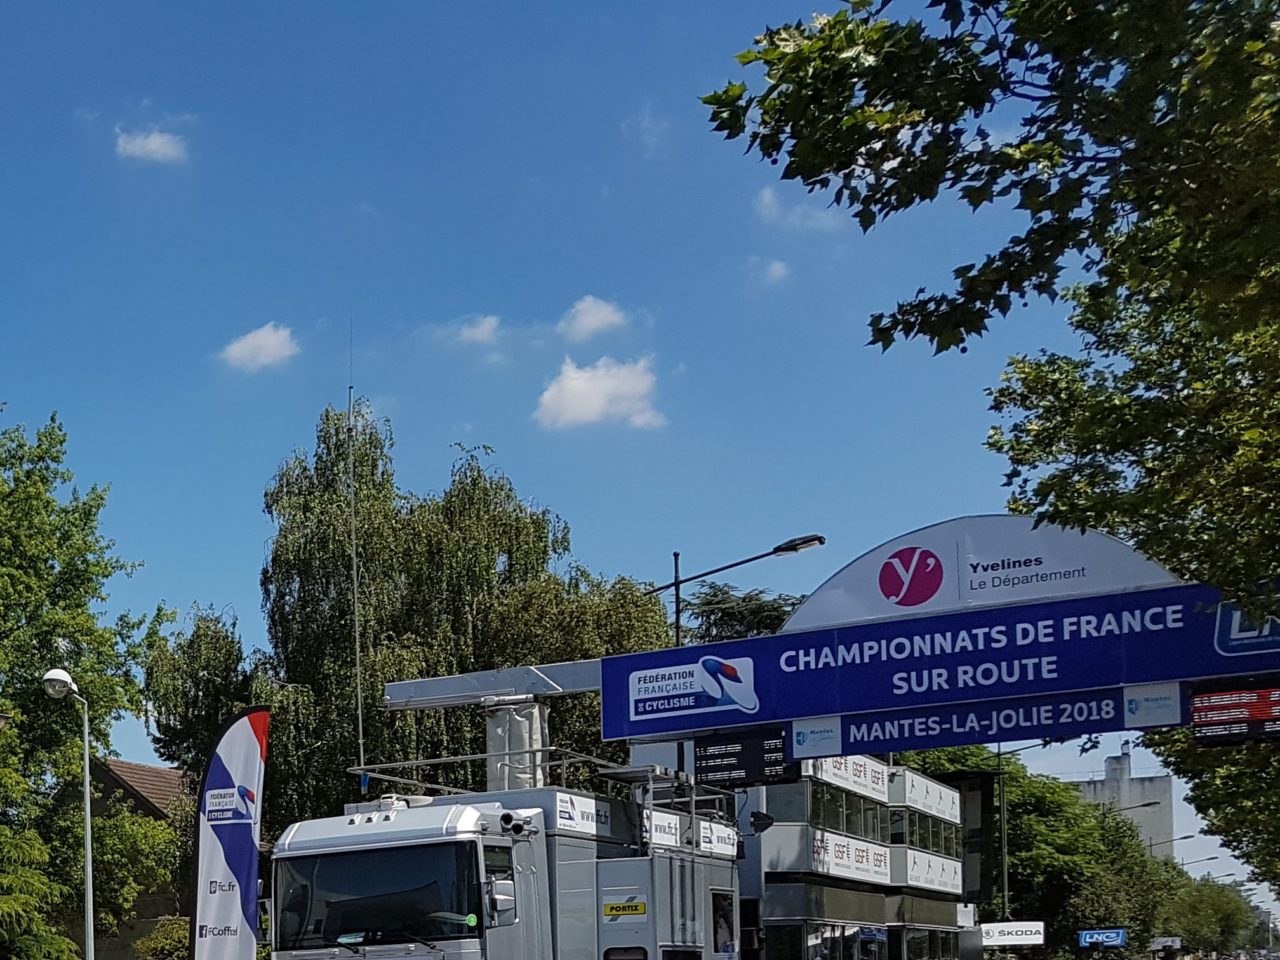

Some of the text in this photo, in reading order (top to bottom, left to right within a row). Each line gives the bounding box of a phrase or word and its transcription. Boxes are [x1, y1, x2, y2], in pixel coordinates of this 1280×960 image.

[969, 556, 1043, 574] Yvelines
[970, 567, 1086, 591] Le Département
[779, 605, 1184, 673] CHAMPIONNATS DE FRANCE
[637, 670, 695, 685] FÉDÉRATION
[892, 656, 1058, 695] SUR ROUTE
[637, 681, 695, 696] FRANÇAISE
[645, 696, 696, 711] CYCLISME
[849, 699, 1115, 744] MANTES-LA-JOLIE 2018
[997, 928, 1042, 937] ŠKODA
[1085, 932, 1112, 943] LNC
